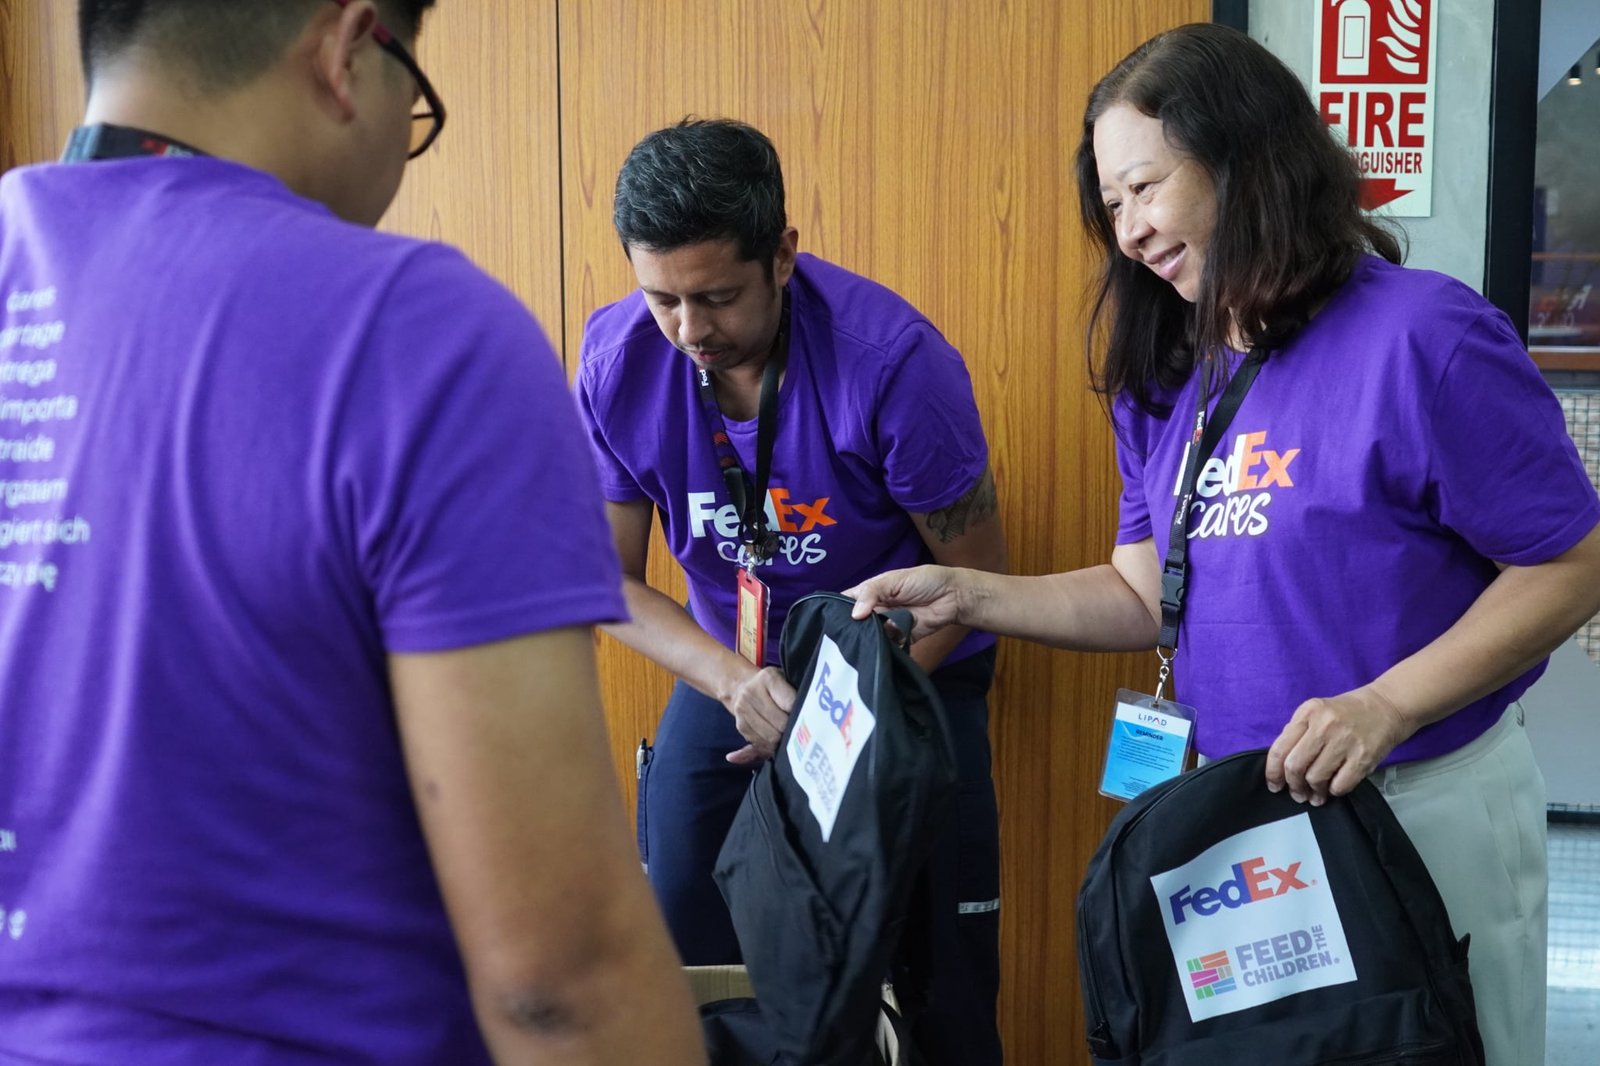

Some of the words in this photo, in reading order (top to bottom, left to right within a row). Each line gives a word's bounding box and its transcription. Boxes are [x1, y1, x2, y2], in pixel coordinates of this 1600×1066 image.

[1319, 92, 1426, 148] FIRE
[1357, 152, 1423, 174] GUISHER
[1173, 431, 1301, 498] edEx
[1186, 492, 1271, 539] cares
[1169, 857, 1309, 926] FedEx
[1235, 929, 1313, 971] FEED
[1311, 924, 1328, 950] THE
